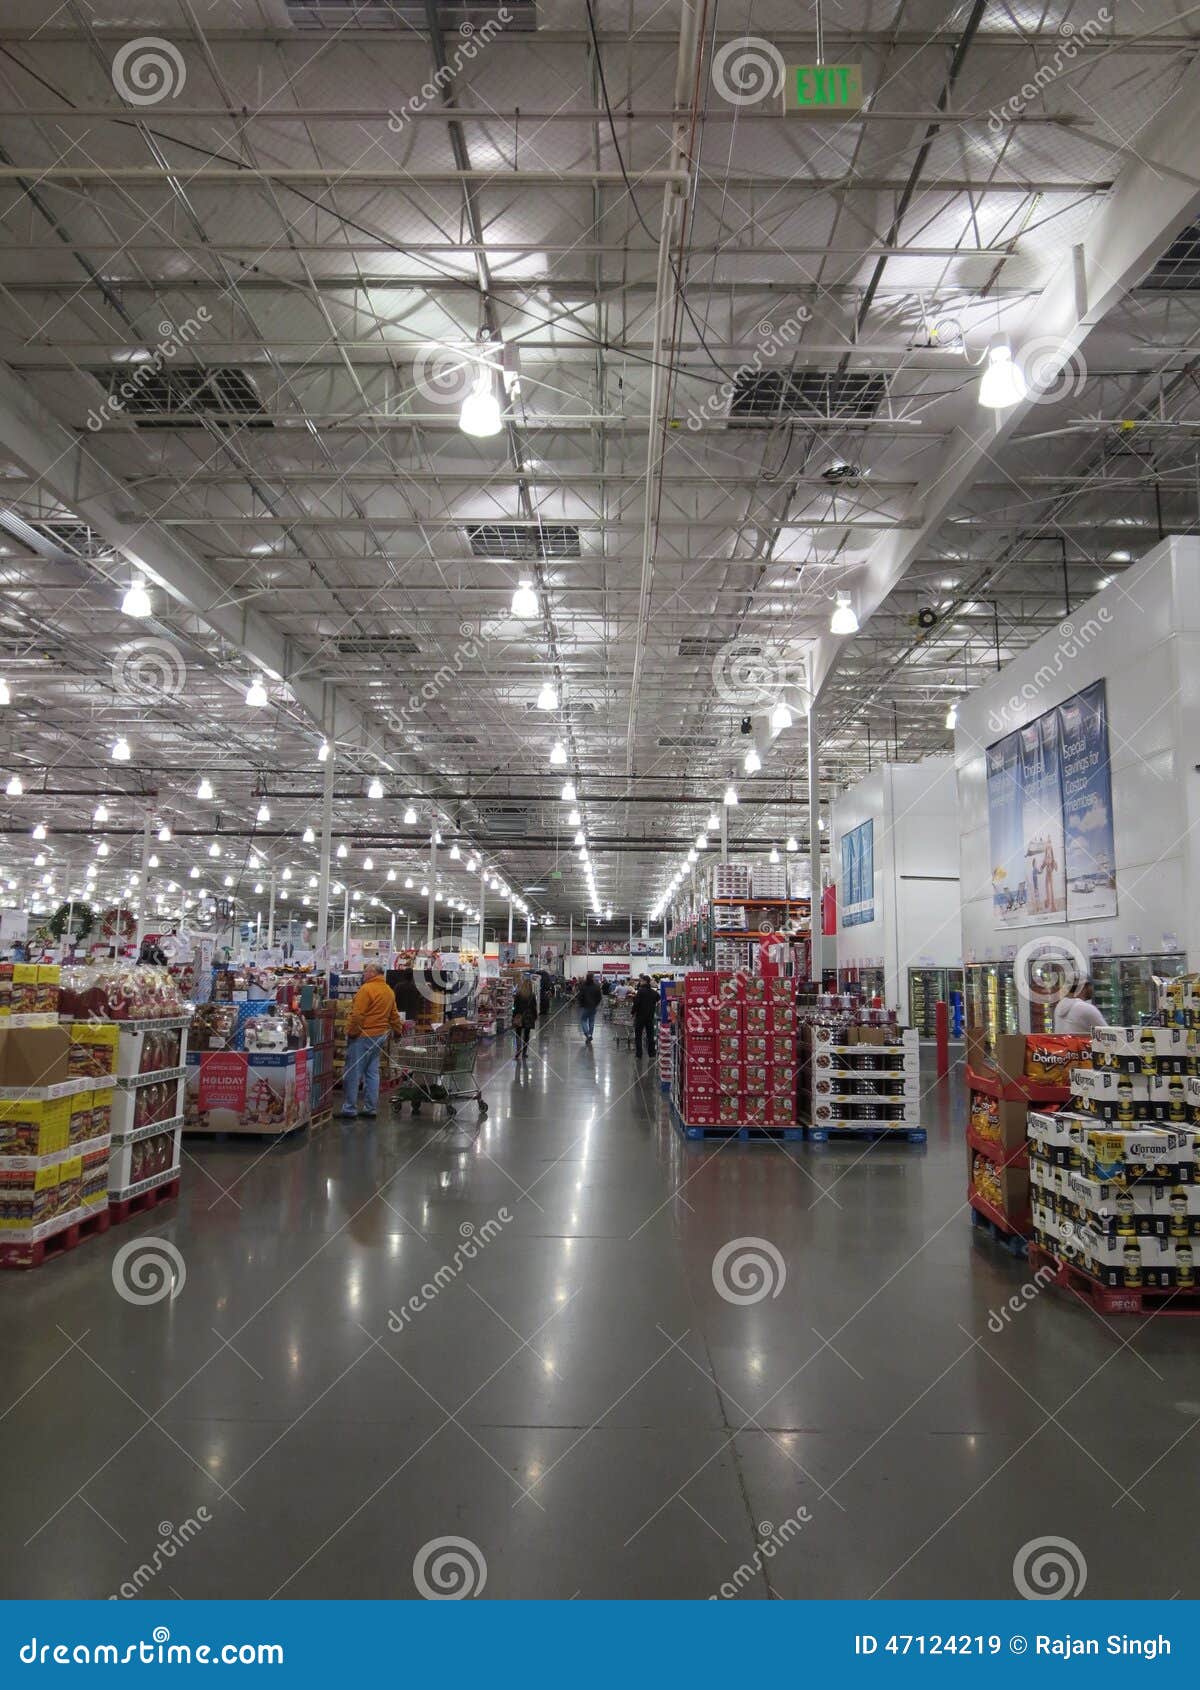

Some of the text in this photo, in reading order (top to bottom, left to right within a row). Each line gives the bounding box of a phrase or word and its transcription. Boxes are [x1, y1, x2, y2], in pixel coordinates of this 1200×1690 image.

[797, 68, 849, 105] EXIT
[202, 1076, 243, 1085] HOLIDAY
[1130, 1143, 1167, 1155] Corona
